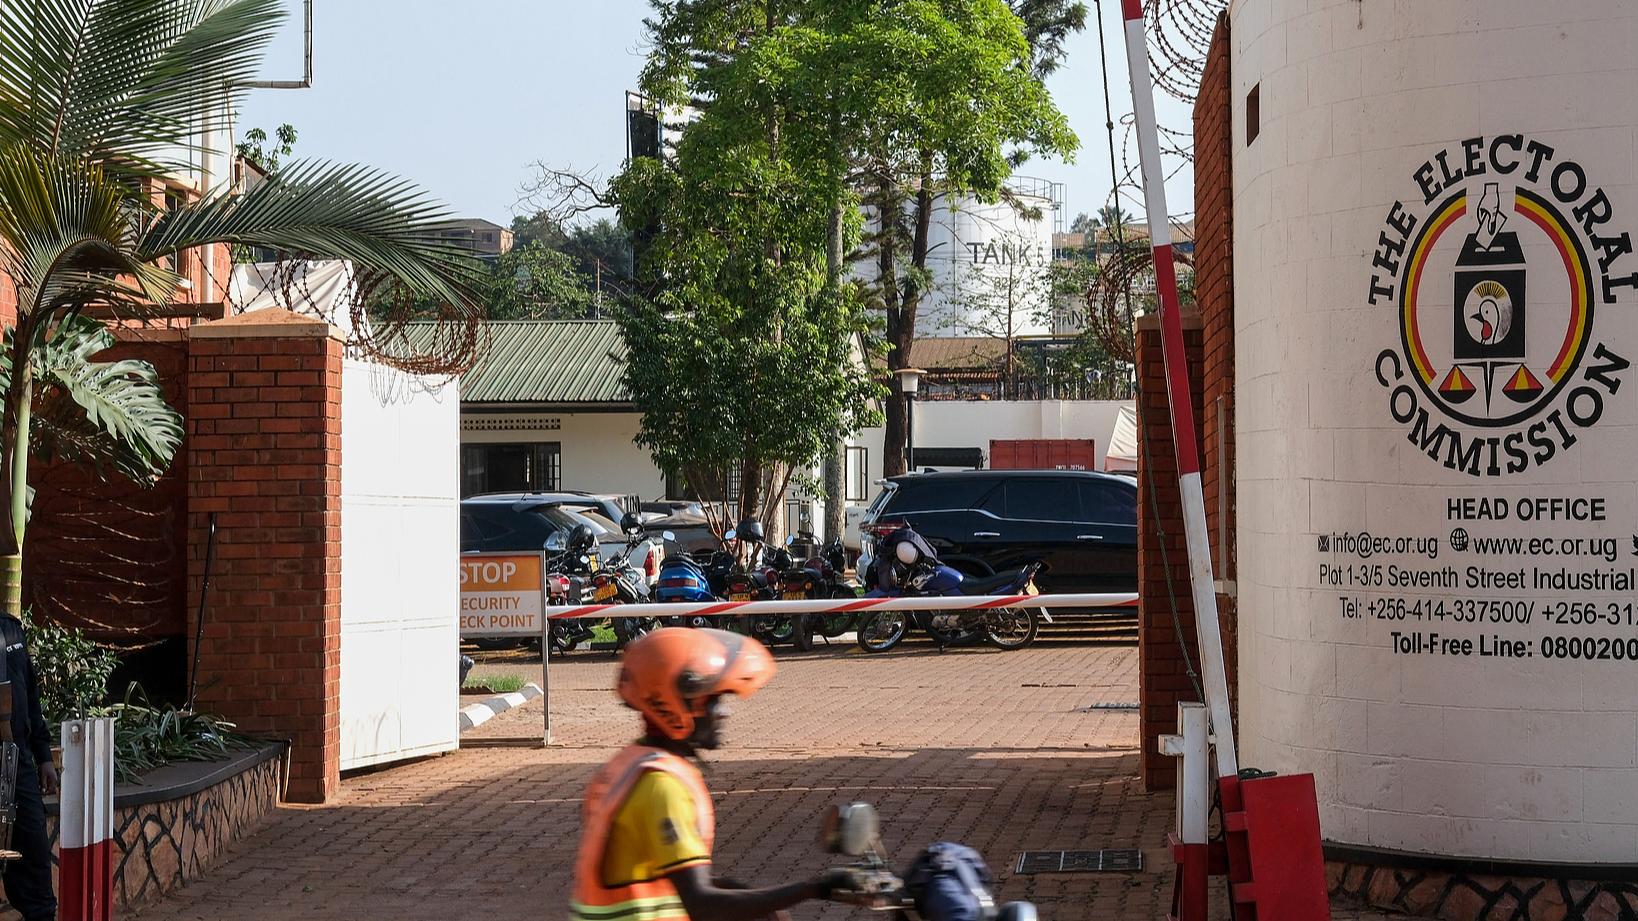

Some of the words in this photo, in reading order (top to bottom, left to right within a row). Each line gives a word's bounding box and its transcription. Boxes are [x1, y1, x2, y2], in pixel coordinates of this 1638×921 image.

[1368, 200, 1418, 306] THE
[1412, 133, 1638, 304] ELECTORAL
[966, 242, 1031, 266] TANK
[1375, 342, 1631, 477] COMMISSION
[1447, 497, 1509, 521] HEAD
[1516, 497, 1606, 522] OFFICE
[1332, 531, 1438, 559] info@ec.or.ug
[1473, 536, 1618, 562] www.ec.or.ug
[460, 562, 517, 584] STOP
[1319, 564, 1342, 586] Plot
[1346, 565, 1383, 587] 1-3/5
[1388, 564, 1459, 588] Seventh
[1465, 566, 1526, 589] Street
[1533, 567, 1635, 591] Industrial
[461, 597, 520, 610] ECURITY
[1339, 597, 1362, 618] Tel:
[1367, 598, 1535, 624] +256-414-337500/
[1541, 603, 1638, 625] +256-31
[460, 615, 485, 628] ECK
[490, 614, 534, 628] POINT
[1391, 631, 1473, 656] Toll-Free
[1480, 634, 1533, 658] Line:
